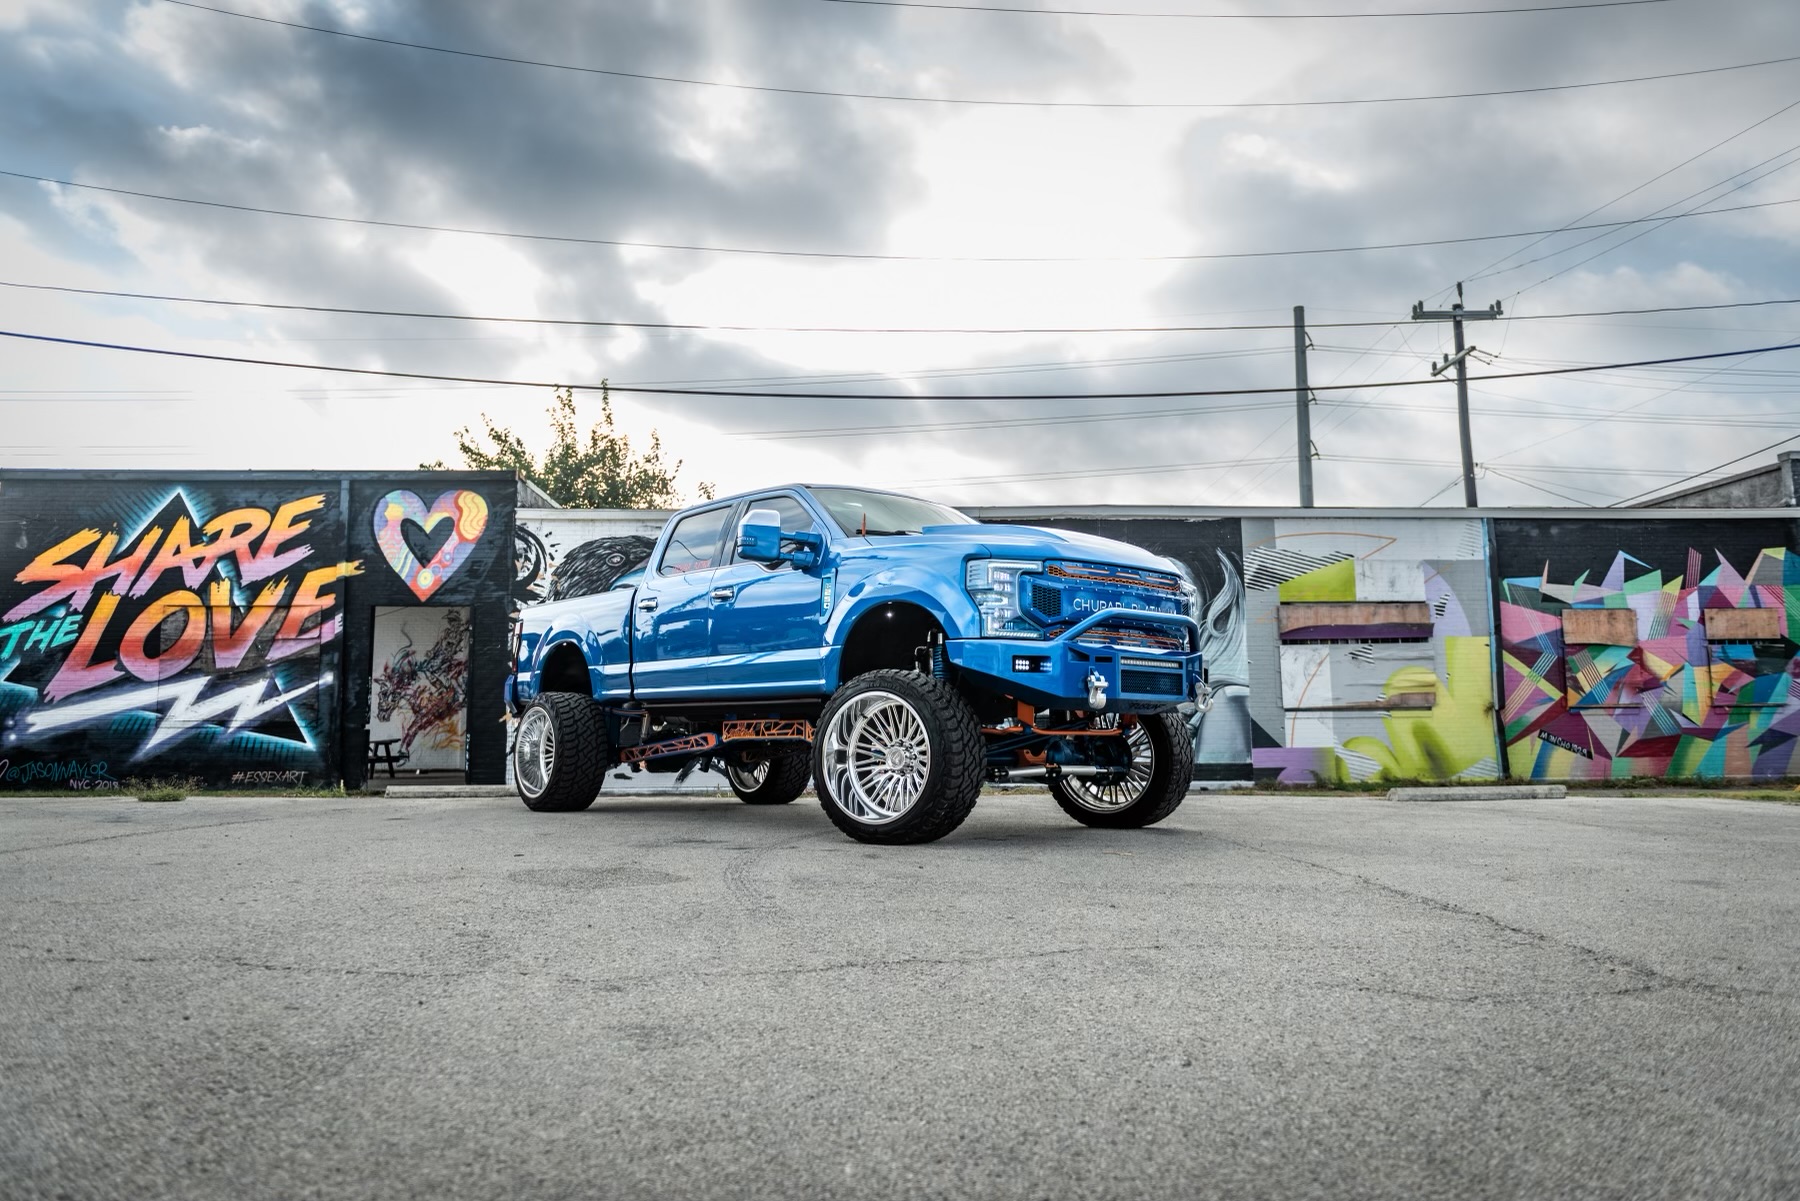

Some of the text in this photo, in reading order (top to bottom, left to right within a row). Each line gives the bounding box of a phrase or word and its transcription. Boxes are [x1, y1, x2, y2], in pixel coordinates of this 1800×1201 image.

[2, 494, 327, 622] SHARE
[0, 559, 365, 704] THE LOVE
[6, 760, 117, 783] @JASONNAYLOR
[231, 770, 309, 784] #ESSEXART
